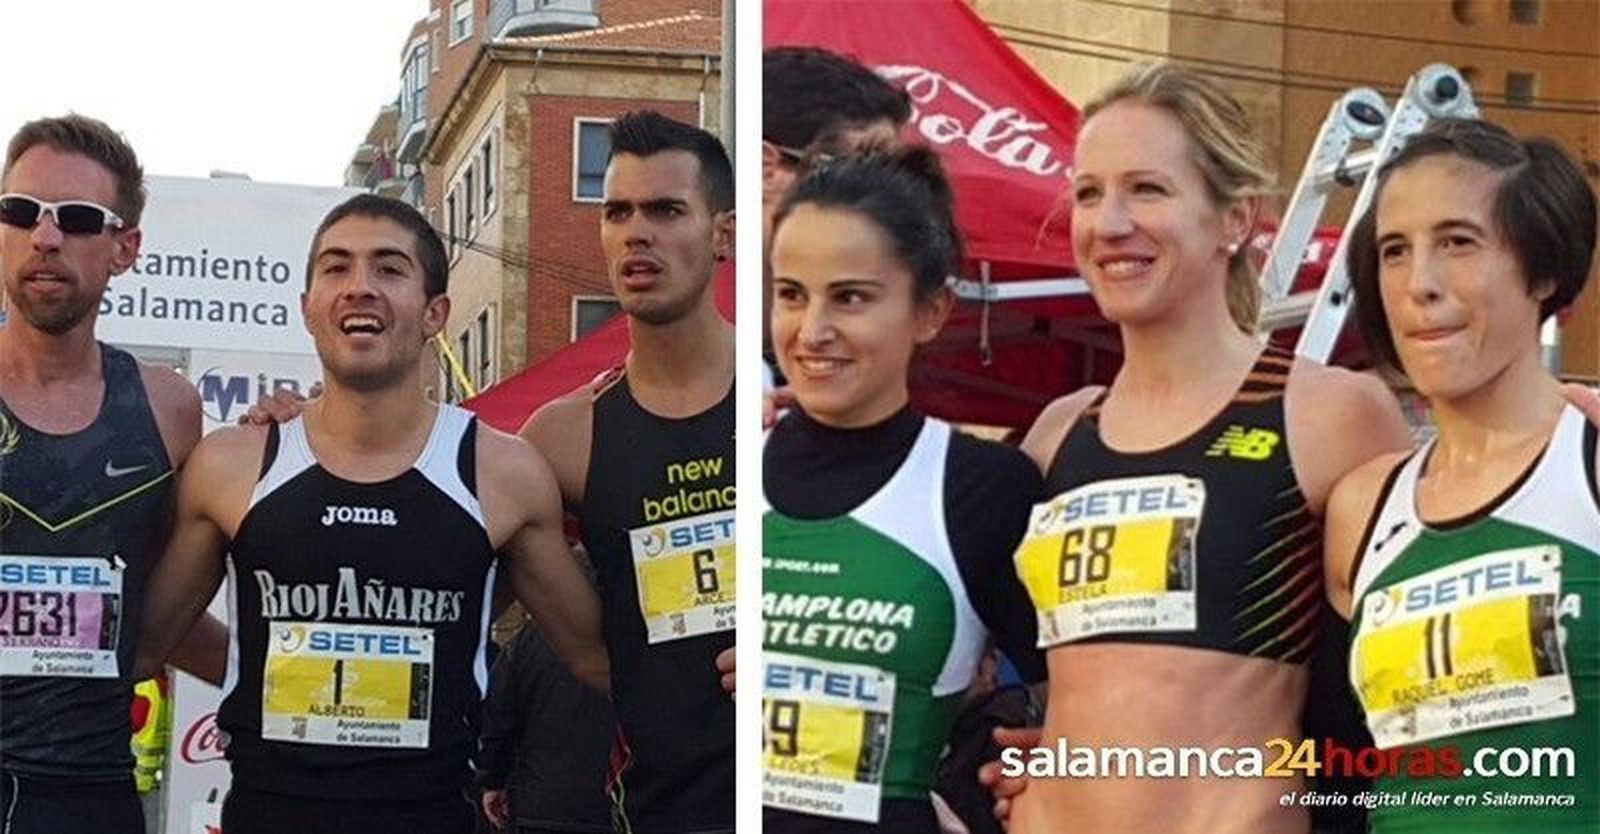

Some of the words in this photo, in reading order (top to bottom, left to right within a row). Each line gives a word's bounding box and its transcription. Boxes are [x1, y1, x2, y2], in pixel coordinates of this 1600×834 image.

[873, 64, 1062, 176] ola
[99, 287, 288, 327] Salamanca
[667, 457, 723, 484] new
[1063, 486, 1188, 523] SETEL
[693, 547, 719, 594] 6
[1058, 524, 1118, 588] 68
[1, 564, 111, 587] SETEL
[1405, 560, 1543, 613] SETEL
[762, 592, 916, 629] AMPLONA
[308, 630, 422, 656] SETEL
[1423, 612, 1453, 680] 11
[333, 659, 344, 705] 1
[766, 664, 878, 702] ETEL
[1392, 680, 1447, 704] RAQUEL
[1454, 667, 1495, 693] GOME
[308, 703, 365, 719] ALBERTO
